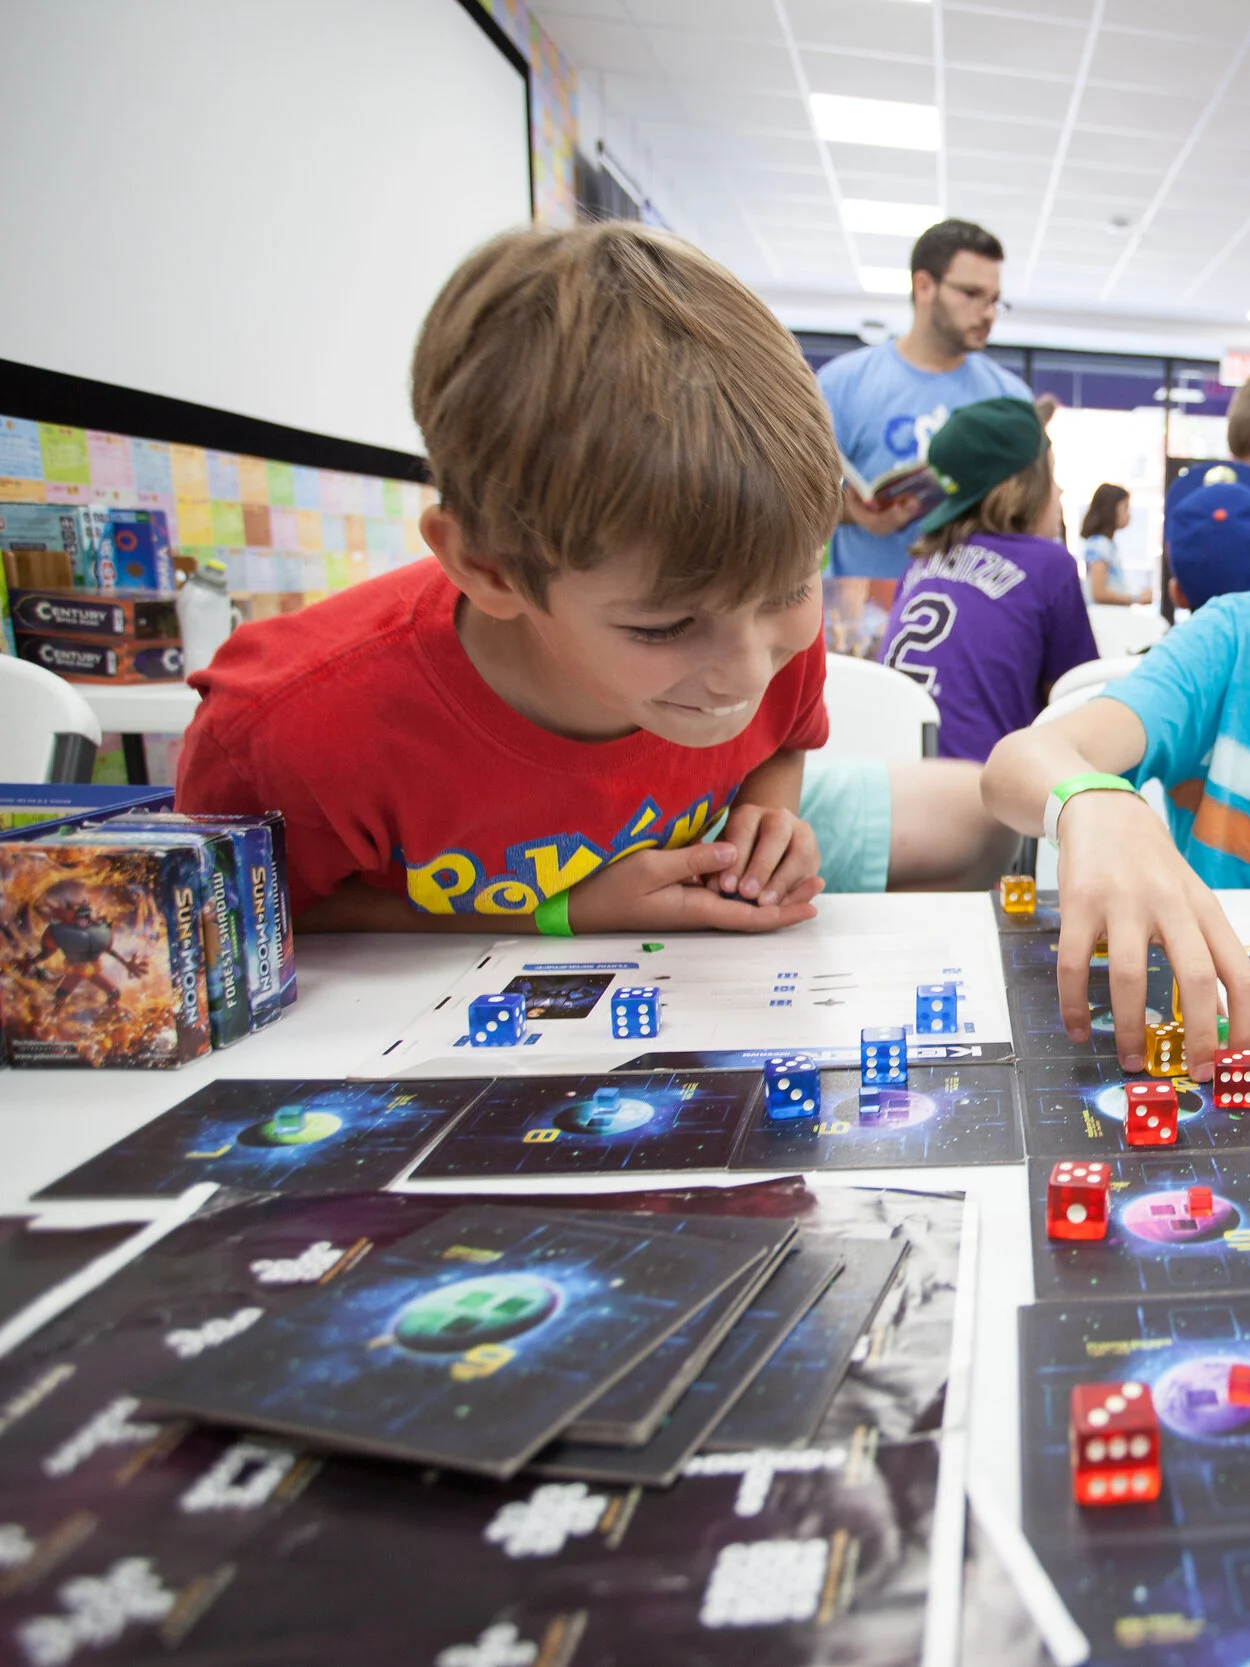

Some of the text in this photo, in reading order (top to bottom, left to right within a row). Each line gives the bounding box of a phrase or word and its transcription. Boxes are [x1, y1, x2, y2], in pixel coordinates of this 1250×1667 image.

[35, 601, 107, 621] CENTURY
[39, 644, 102, 664] CENTURY
[213, 872, 238, 1009] FOREST SHADOW
